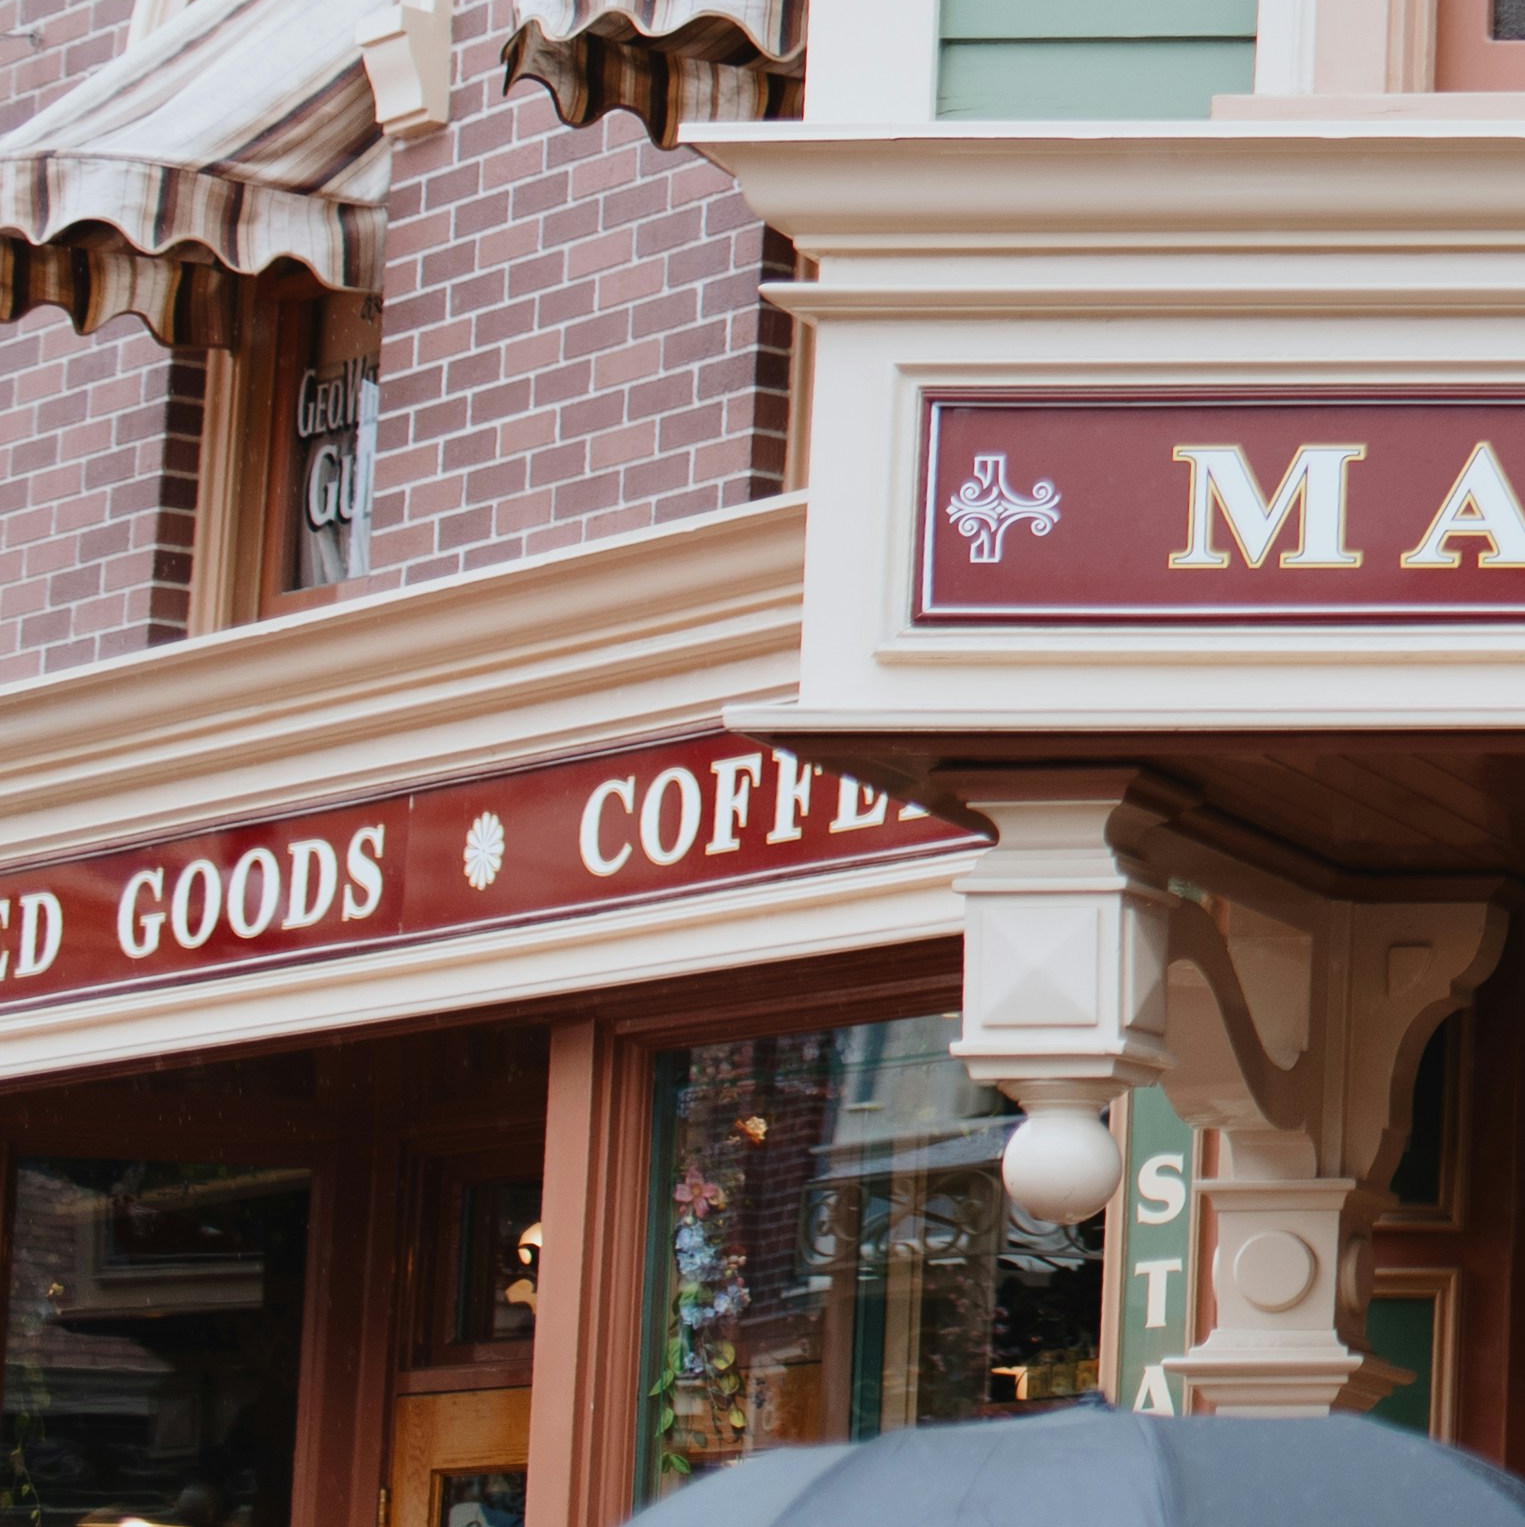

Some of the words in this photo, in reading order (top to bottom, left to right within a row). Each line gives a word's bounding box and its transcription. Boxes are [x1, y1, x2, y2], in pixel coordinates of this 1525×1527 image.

[0, 891, 63, 982] D
[117, 823, 385, 959] GOODS
[579, 748, 930, 877] COFFE
[1132, 1140, 1187, 1417] STA
